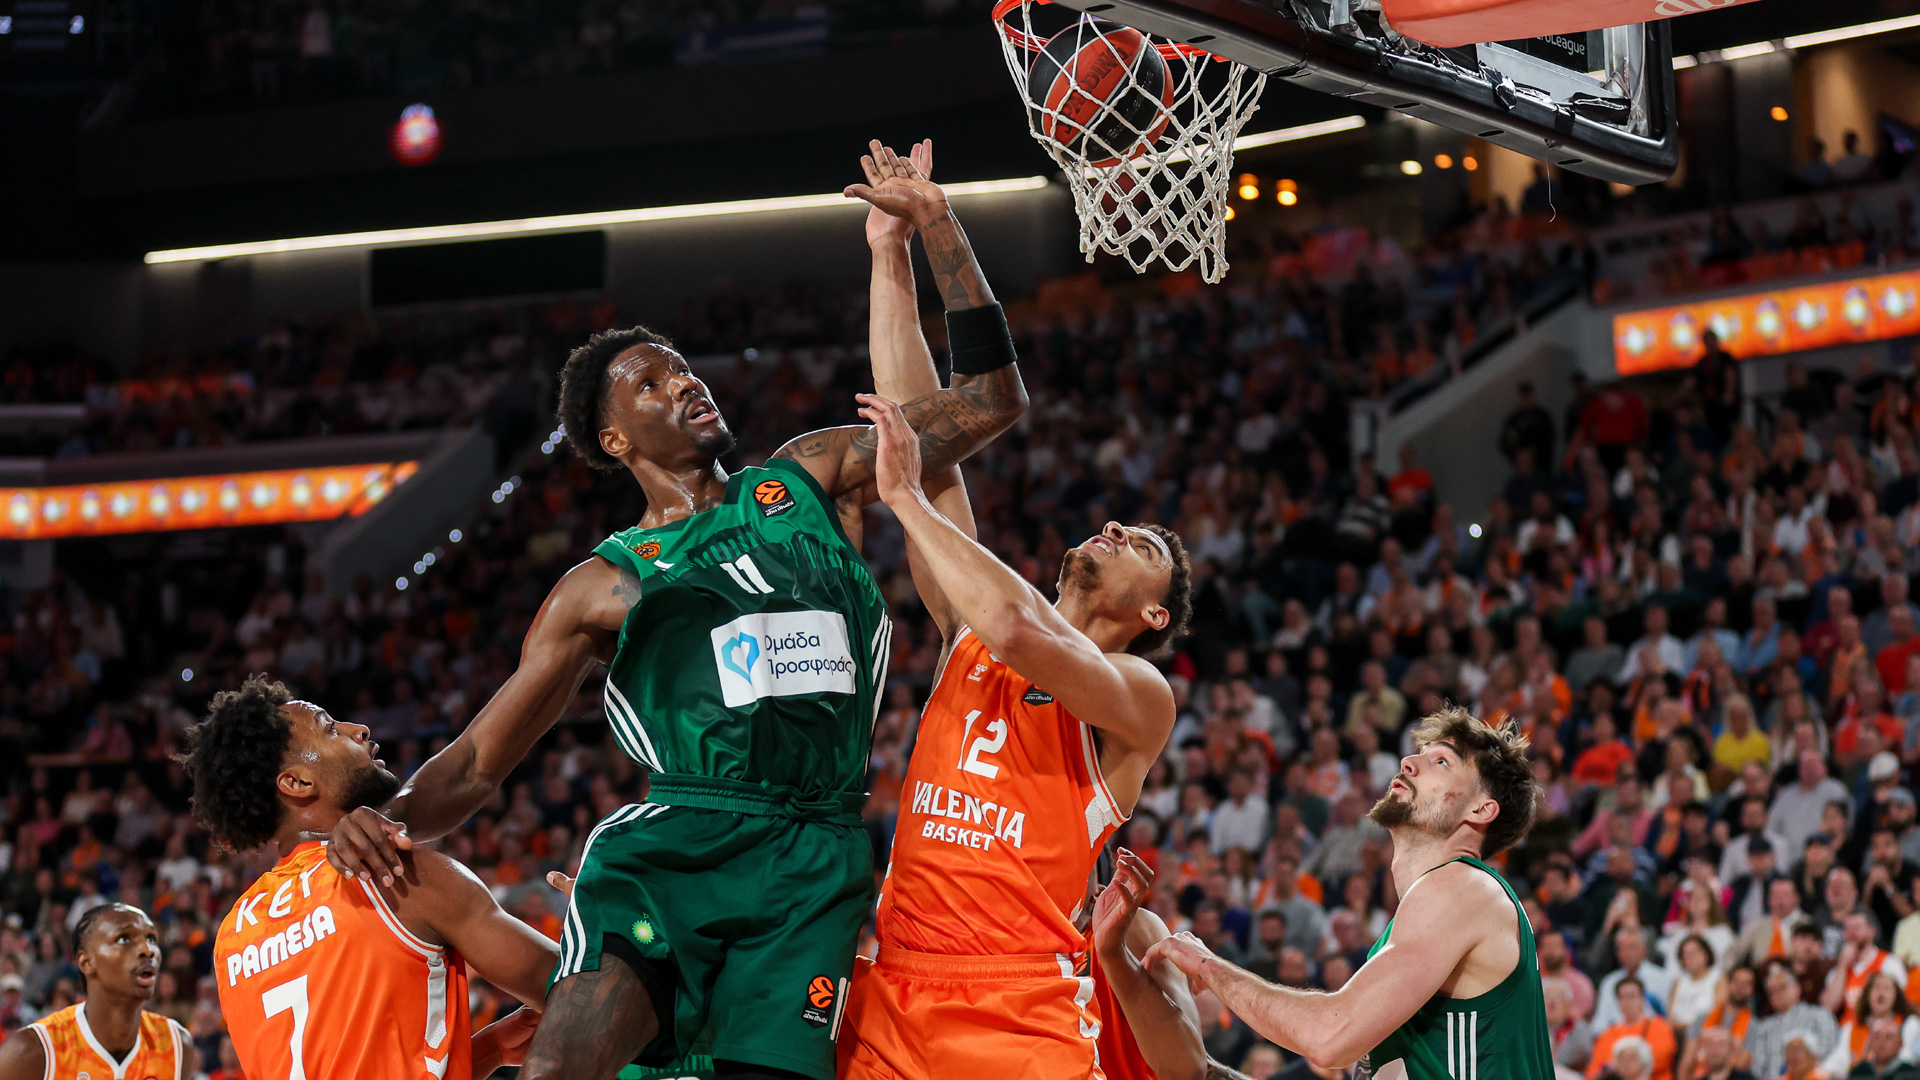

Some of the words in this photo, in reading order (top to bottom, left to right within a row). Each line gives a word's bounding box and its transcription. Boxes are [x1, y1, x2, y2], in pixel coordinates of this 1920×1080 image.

[1536, 35, 1585, 56] oLeague
[719, 554, 776, 595] 11
[957, 709, 1008, 779] 12
[912, 781, 1025, 849] VALENCIA
[922, 820, 995, 851] BASKET
[235, 859, 326, 933] KEY
[227, 905, 336, 987] PAMESA
[261, 974, 309, 1080] 7
